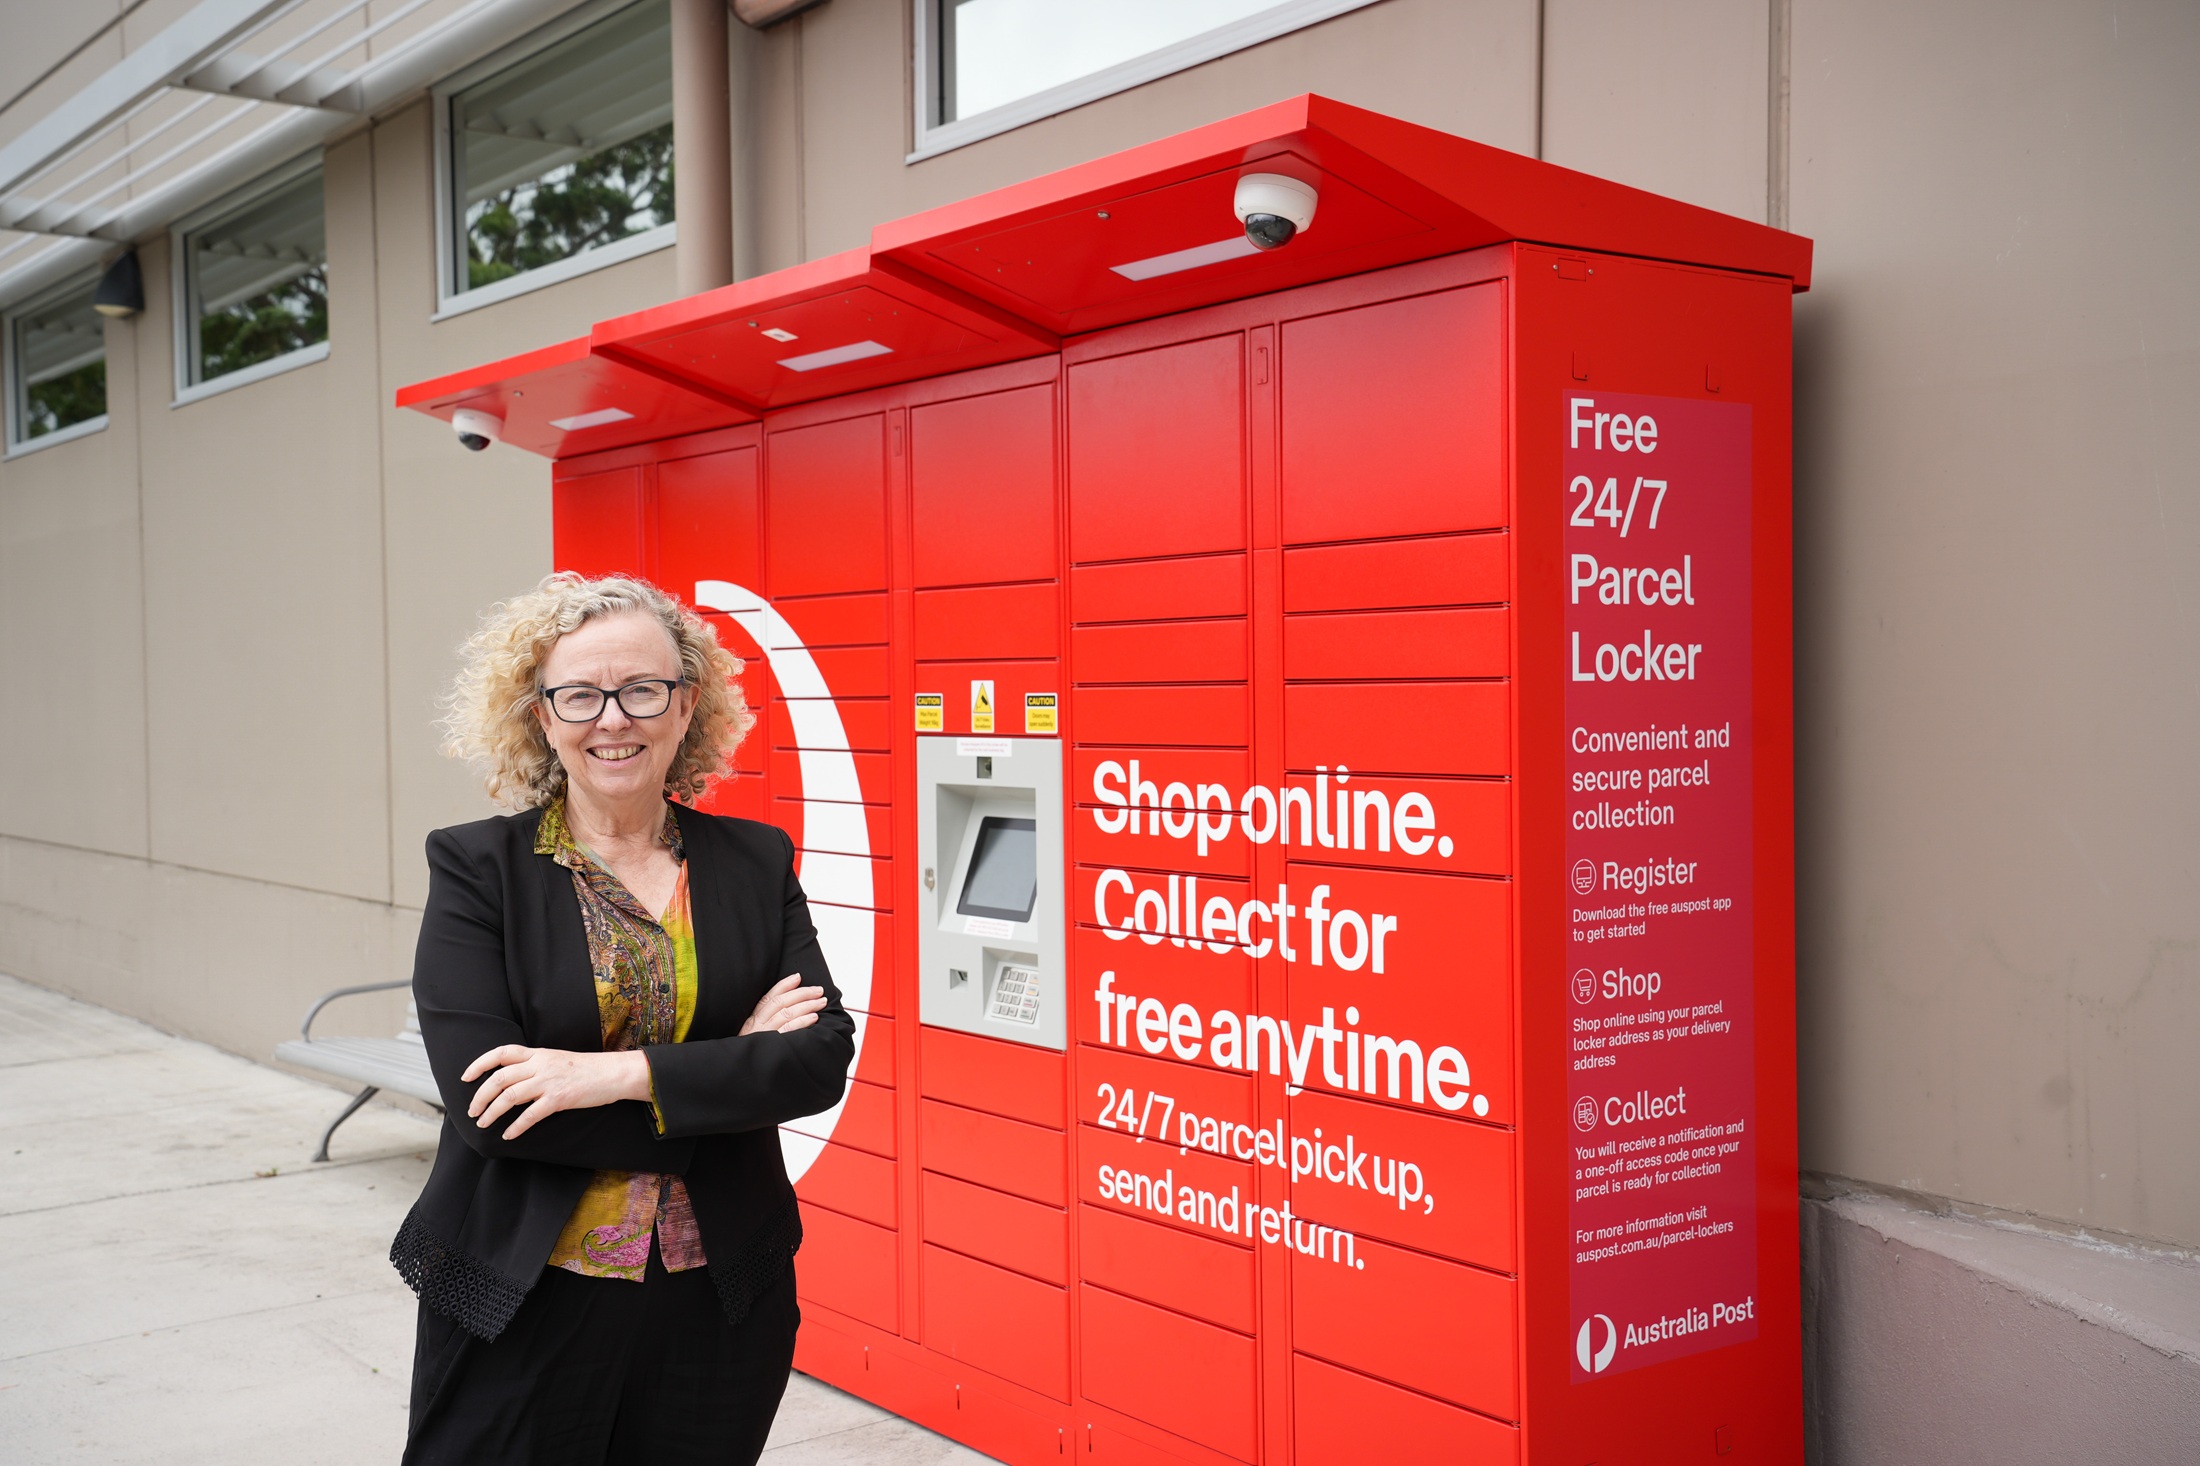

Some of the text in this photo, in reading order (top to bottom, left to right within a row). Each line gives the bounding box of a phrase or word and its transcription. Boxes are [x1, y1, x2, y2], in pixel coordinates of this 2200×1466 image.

[1571, 398, 1658, 453] Free
[1569, 475, 1667, 538] 24/7
[1571, 553, 1694, 606] Parcel
[1572, 629, 1702, 682] Locker
[1028, 697, 1054, 705] CAUTION
[1572, 722, 1730, 753] Convenient and
[1572, 759, 1710, 793] secure parcel
[1093, 760, 1454, 858] Shop online.
[1572, 800, 1674, 830] collection
[1603, 857, 1697, 895] Register
[1094, 869, 1397, 974] Collect for
[1573, 897, 1732, 923] Download the free auspost app
[1573, 921, 1646, 943] to get started
[1602, 967, 1661, 1000] Shop
[1573, 1000, 1723, 1032] Shop online using your parcel
[1573, 1020, 1731, 1051] locker address as your delivery
[1095, 971, 1202, 1061] free
[1210, 1006, 1489, 1117] anytime.
[1574, 1054, 1616, 1071] address
[1604, 1086, 1686, 1126] Collect
[1097, 1083, 1434, 1215] 24/7 parcel pick up,
[1575, 1119, 1744, 1161] You will receive a notification and
[1576, 1140, 1740, 1180] a one-off access code once your
[1576, 1162, 1721, 1202] parcel is ready for collection
[1098, 1164, 1365, 1270] send and return.
[1576, 1205, 1707, 1244] For more information visit
[1576, 1220, 1734, 1263] auspost.com.au/parcel-lockers
[1623, 1295, 1754, 1349] Australia Post
